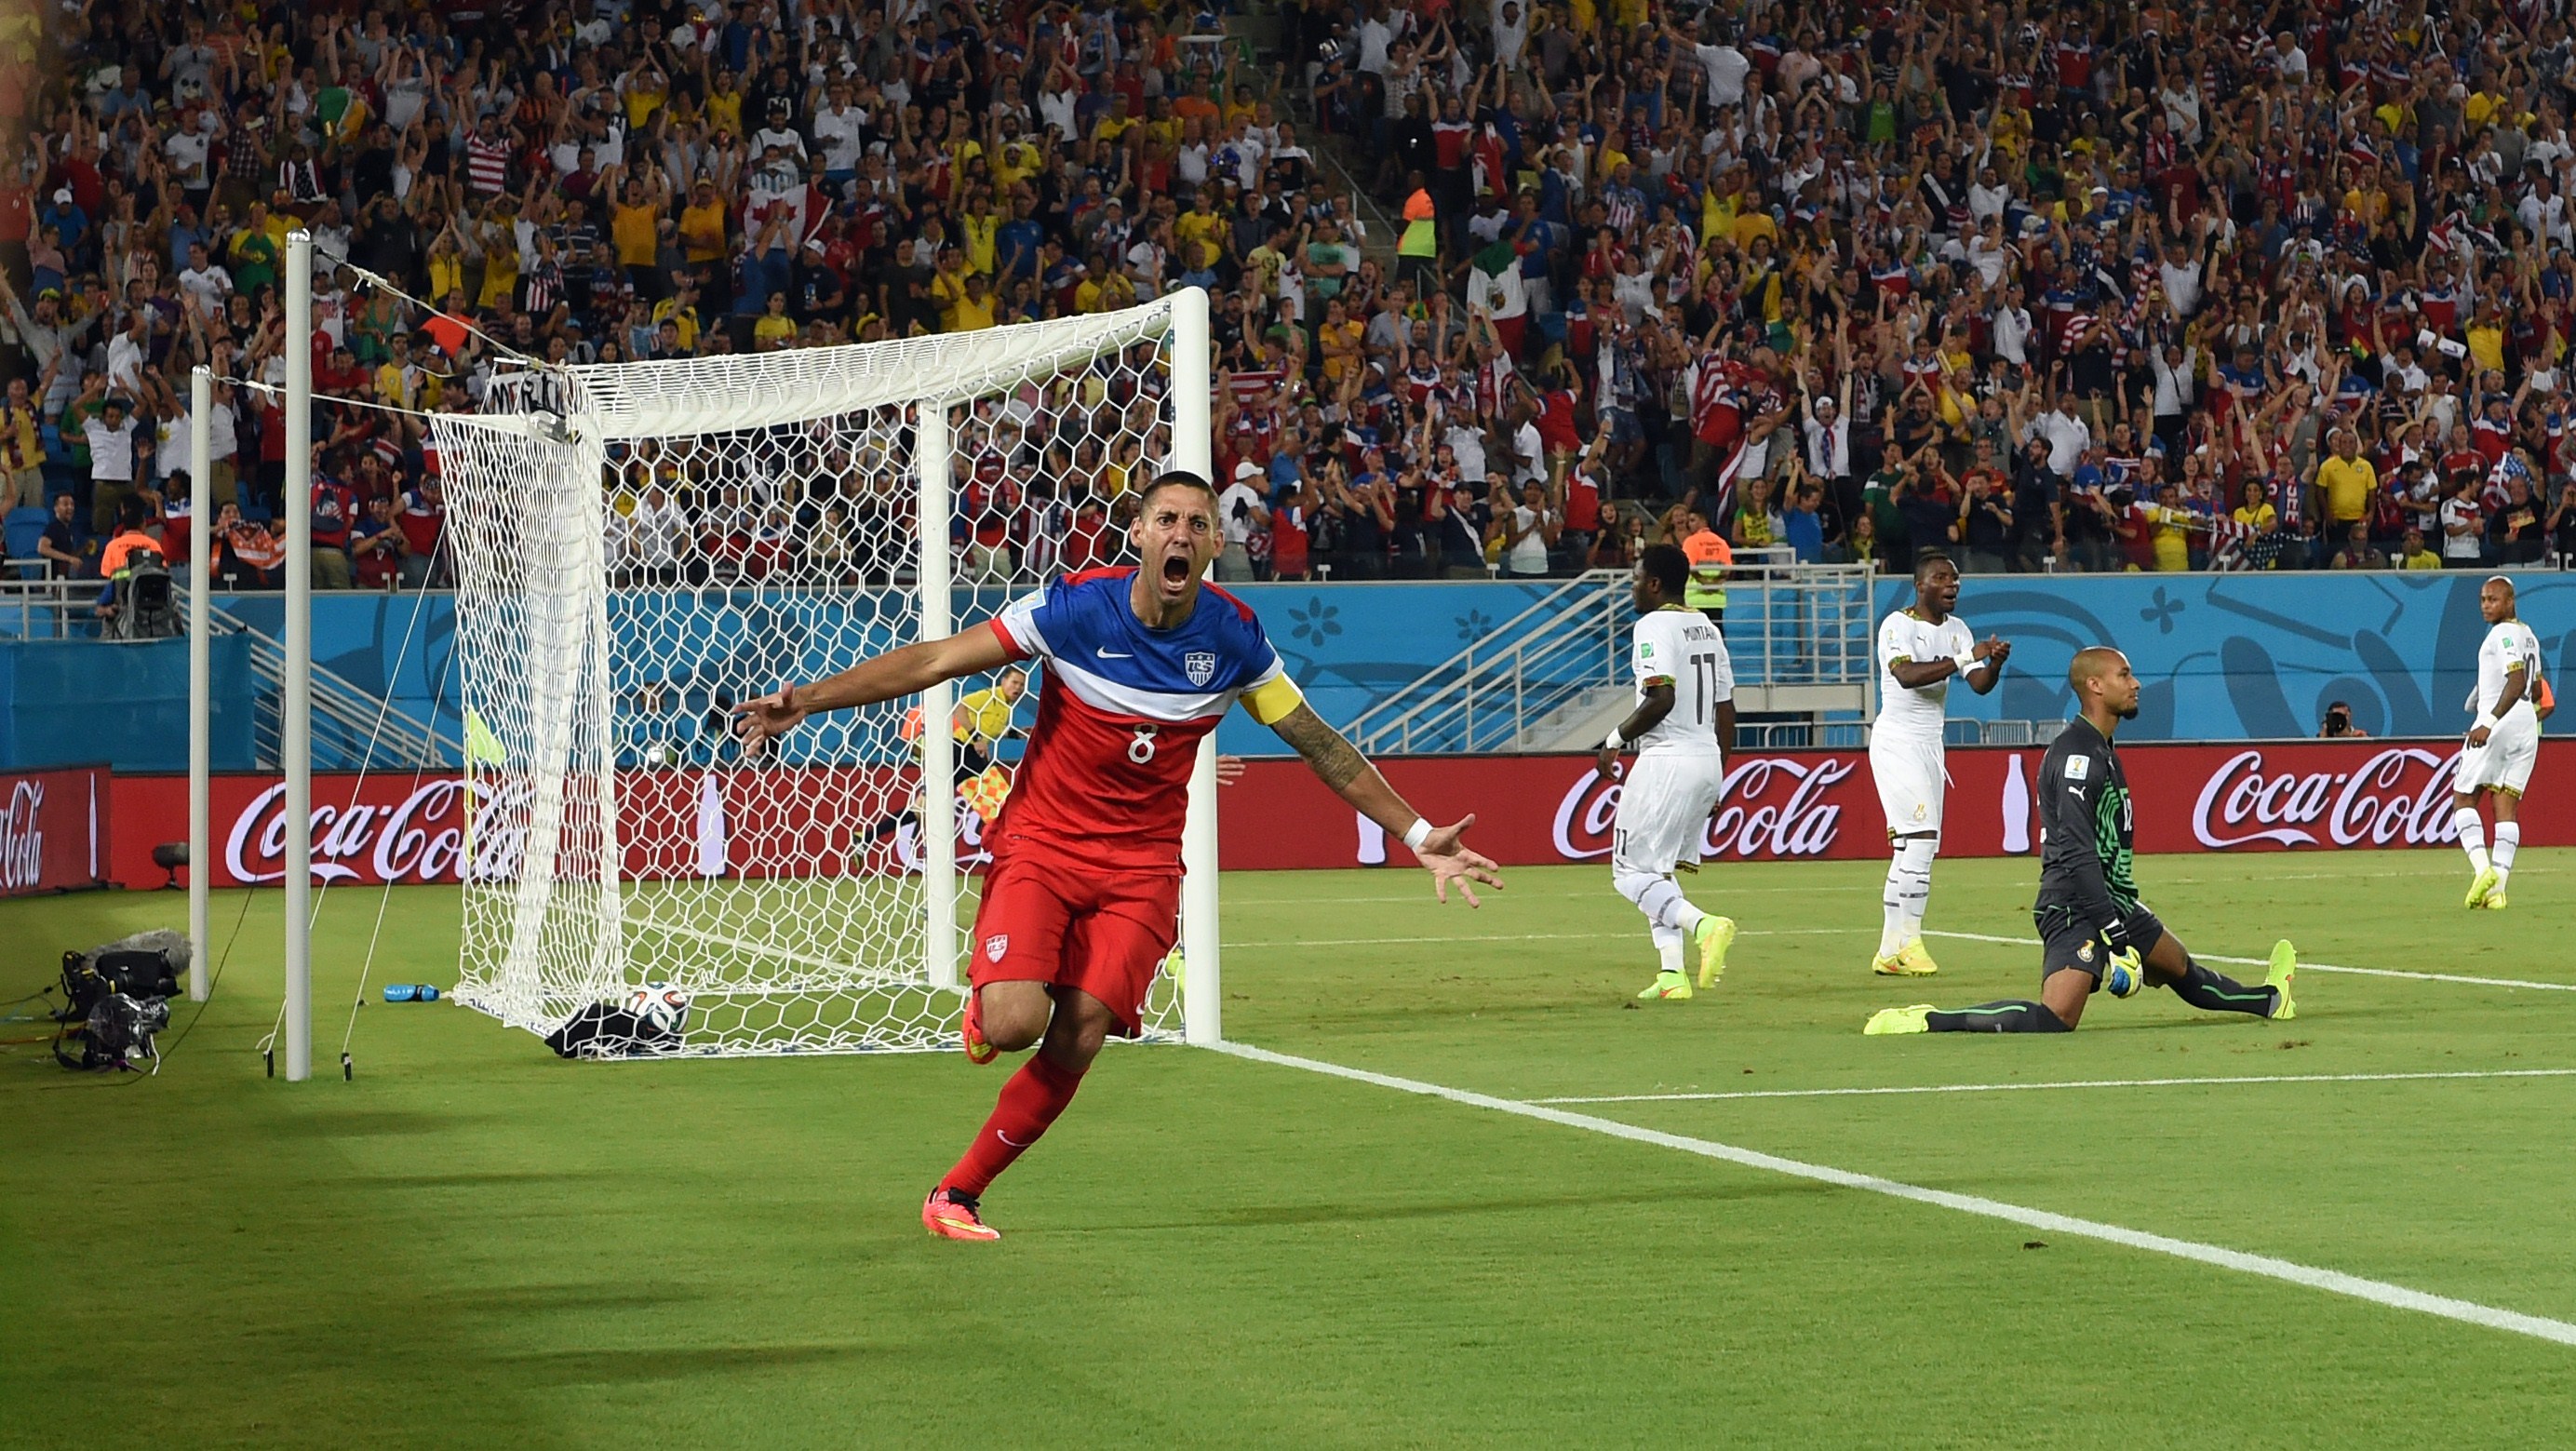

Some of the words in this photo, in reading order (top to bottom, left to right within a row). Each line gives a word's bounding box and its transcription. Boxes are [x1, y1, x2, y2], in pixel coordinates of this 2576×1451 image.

[1690, 653, 1716, 725] 11
[2523, 652, 2536, 701] 0
[1127, 722, 1159, 764] 8
[1552, 758, 1857, 859] CoCola
[2193, 748, 2463, 848] Coca-Cola
